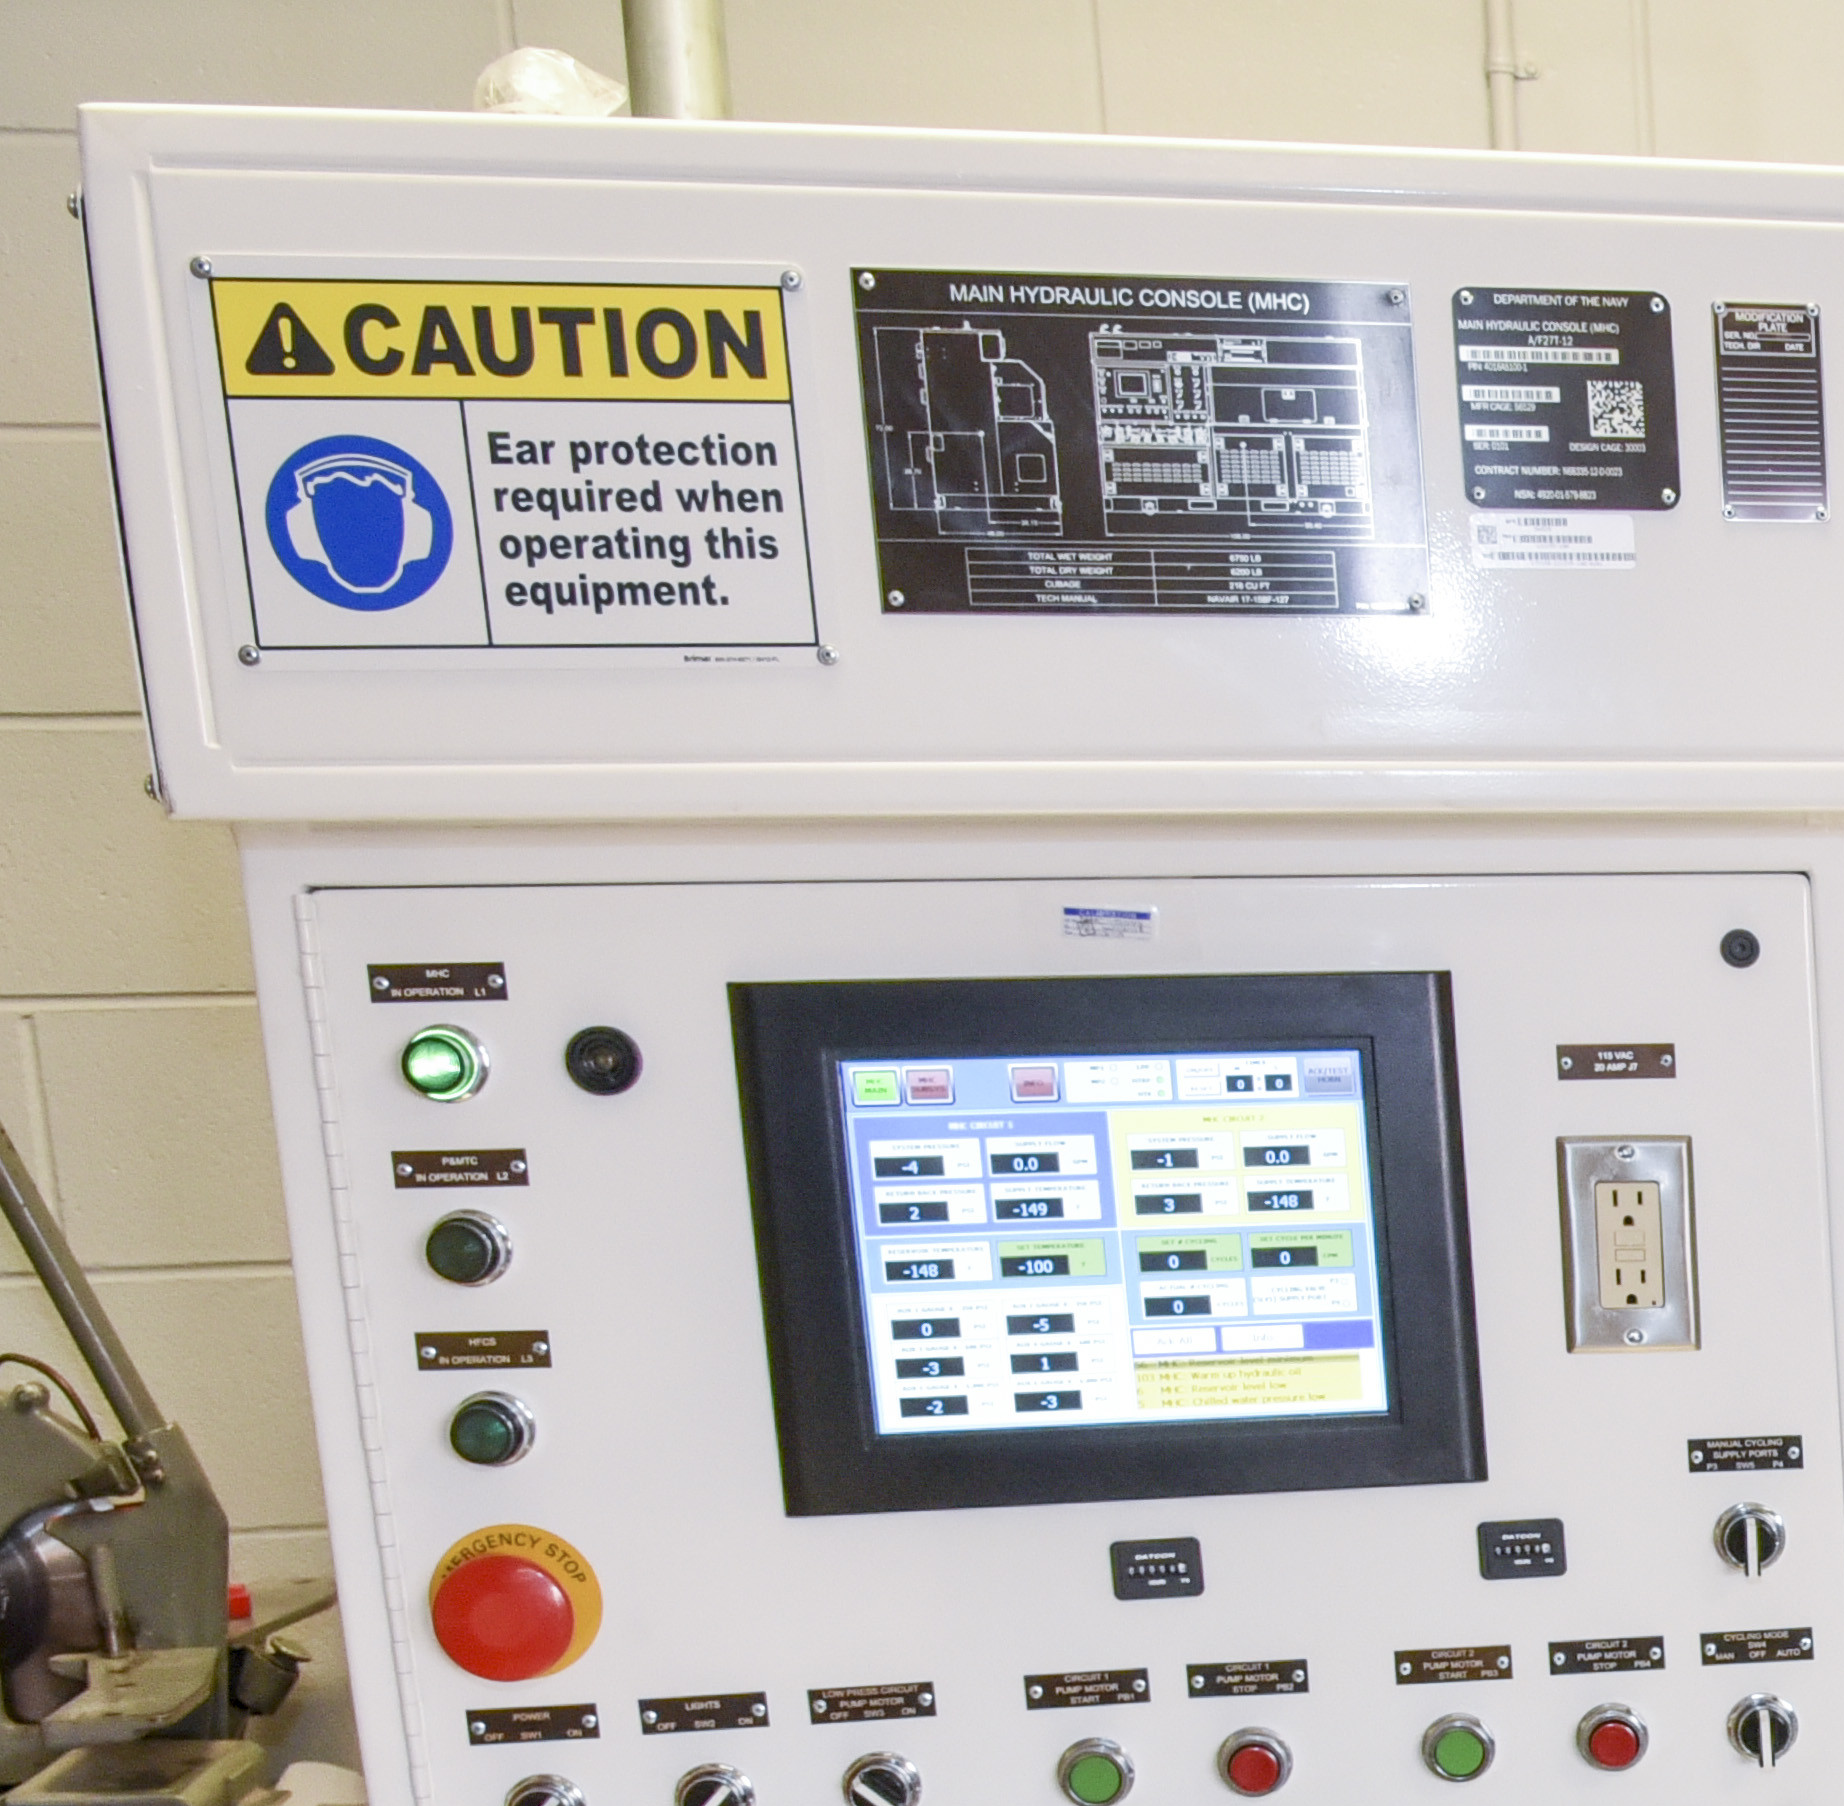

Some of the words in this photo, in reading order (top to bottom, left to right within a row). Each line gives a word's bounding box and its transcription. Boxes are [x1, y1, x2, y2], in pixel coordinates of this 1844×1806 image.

[950, 285, 1003, 302] MAIN
[1010, 286, 1133, 306] HYDRAULIC
[1139, 290, 1242, 309] CONSOLE
[1248, 292, 1309, 315] (MHC)
[1494, 294, 1563, 306] DEPARTMENT
[1565, 295, 1579, 306] OF
[1581, 295, 1600, 306] THE
[1602, 295, 1629, 307] NAVY
[1735, 312, 1803, 323] MODIFICATION
[1458, 320, 1483, 330] MAIN
[1486, 320, 1540, 332] HYDRAULIC
[1542, 322, 1588, 333] CONSOLE
[1590, 323, 1620, 334] (MHC)
[1758, 323, 1787, 332] PLATE
[343, 303, 767, 379] CAUTION
[487, 432, 555, 466] Ear
[570, 433, 777, 472] protection
[494, 481, 663, 521] required
[678, 482, 783, 512] when
[500, 529, 690, 567] operating
[705, 528, 779, 559] this
[1028, 552, 1056, 561] TOTAL
[1079, 553, 1113, 561] WEIGHT
[505, 576, 729, 614] equipment.
[1036, 594, 1059, 602] TECH
[426, 969, 450, 978] MHC
[391, 989, 401, 997] IN
[404, 988, 464, 997] OPERATION
[474, 988, 485, 996] L1
[1614, 1051, 1634, 1059] VAC
[1236, 1080, 1245, 1090] 0
[1275, 1079, 1284, 1089] 0
[442, 1157, 478, 1166] P&MTC
[1157, 1153, 1173, 1167] -1
[1265, 1150, 1290, 1163] 0.0
[902, 1161, 919, 1174] -4
[1013, 1157, 1039, 1171] 0.0
[415, 1174, 426, 1182] IN
[429, 1173, 488, 1182] OPERATION
[497, 1172, 509, 1181] L2
[1164, 1199, 1175, 1212] 3
[1264, 1195, 1299, 1208] -148
[909, 1207, 920, 1220] 2
[1012, 1202, 1048, 1216] -149
[1168, 1255, 1179, 1269] 0
[1279, 1251, 1290, 1265] 0
[903, 1264, 939, 1278] -148
[1018, 1260, 1054, 1274] -100
[1173, 1300, 1184, 1314] 0
[921, 1323, 932, 1336] 0
[1033, 1318, 1050, 1332] -5
[922, 1362, 940, 1375] -3
[1040, 1357, 1050, 1370] 1
[926, 1401, 943, 1414] -2
[1040, 1396, 1057, 1409] -3
[1707, 1440, 1743, 1448] MANUAL
[1745, 1439, 1783, 1447] CYCLING
[1713, 1450, 1746, 1459] SUPPLY
[1749, 1449, 1778, 1458] PORTS
[442, 1532, 542, 1580] MERGENCY
[545, 1542, 587, 1583] STOP
[1064, 1674, 1101, 1683] CIRCUIT
[1055, 1686, 1082, 1695] PUMP
[1084, 1683, 1118, 1693] MOTOR
[1070, 1695, 1100, 1704] START
